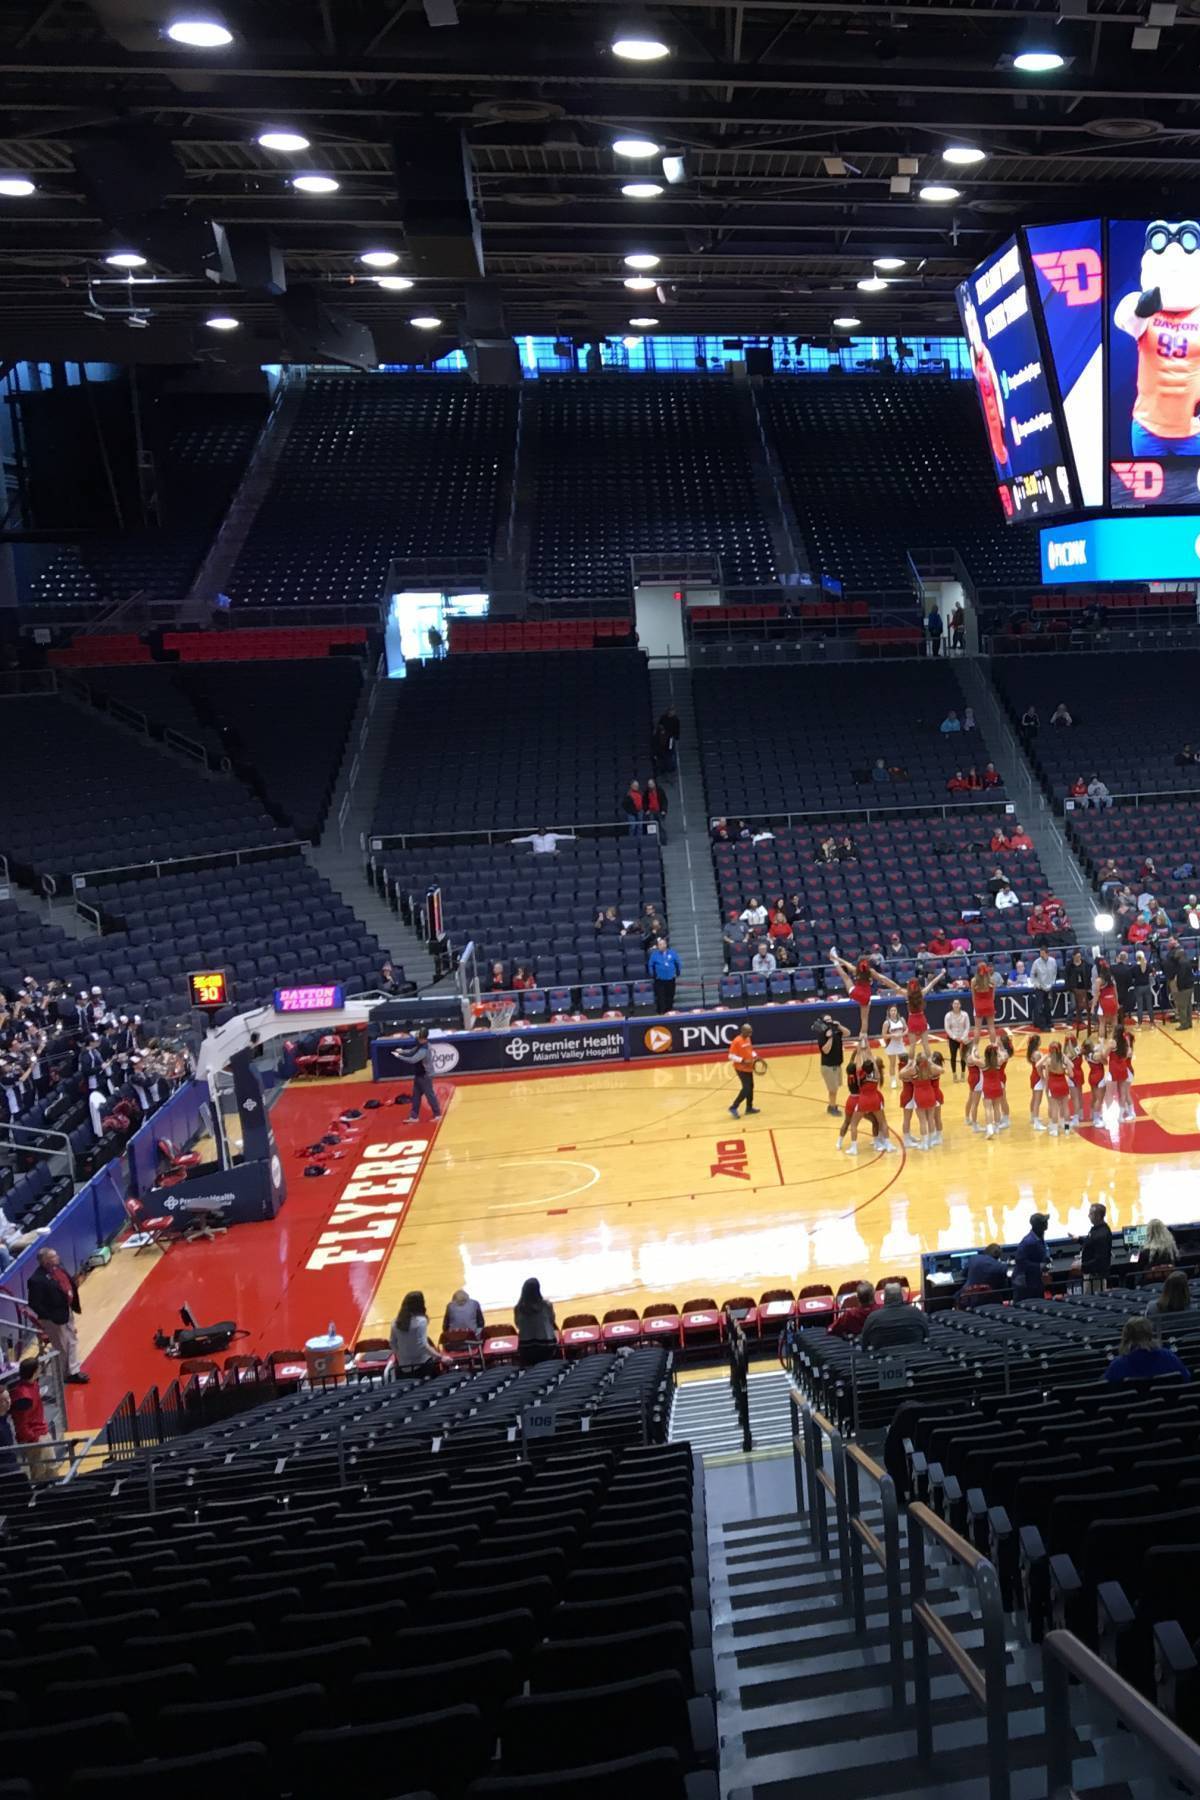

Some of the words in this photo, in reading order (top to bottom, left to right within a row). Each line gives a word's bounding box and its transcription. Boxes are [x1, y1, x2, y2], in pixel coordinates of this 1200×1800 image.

[200, 986, 219, 1001] 30
[279, 986, 336, 1001] DAYTON
[282, 997, 333, 1010] FLYERS
[532, 1038, 580, 1053] Premier
[583, 1033, 625, 1048] Health
[680, 1023, 740, 1048] PNC
[532, 1051, 559, 1063] Miami
[560, 1049, 585, 1061] Valley
[586, 1045, 620, 1059] Hospital
[305, 1139, 429, 1270] FLYERS
